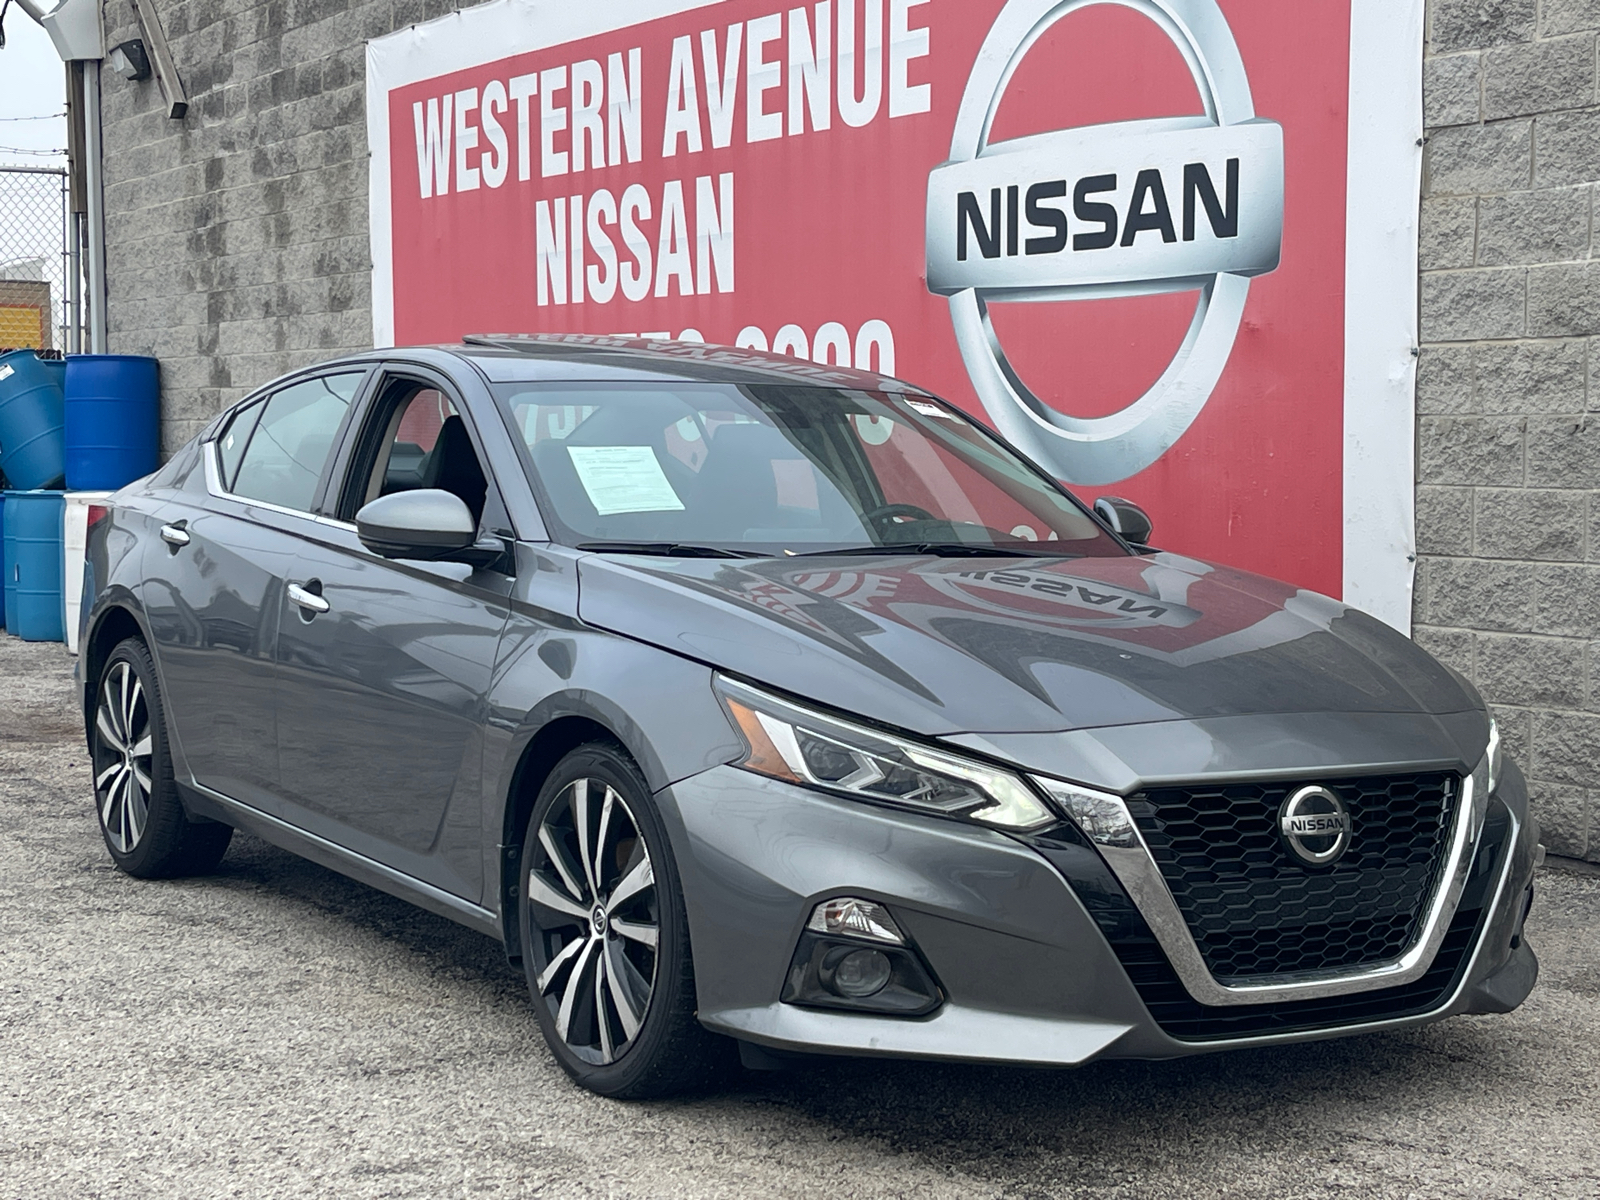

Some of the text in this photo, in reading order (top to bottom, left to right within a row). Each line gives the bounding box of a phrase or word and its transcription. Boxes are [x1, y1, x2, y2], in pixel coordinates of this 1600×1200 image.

[412, 0, 932, 200] WESTERN AVENUE
[535, 171, 735, 307] NISSAN
[957, 156, 1240, 262] NISSAN
[1290, 817, 1344, 831] NISSAN
